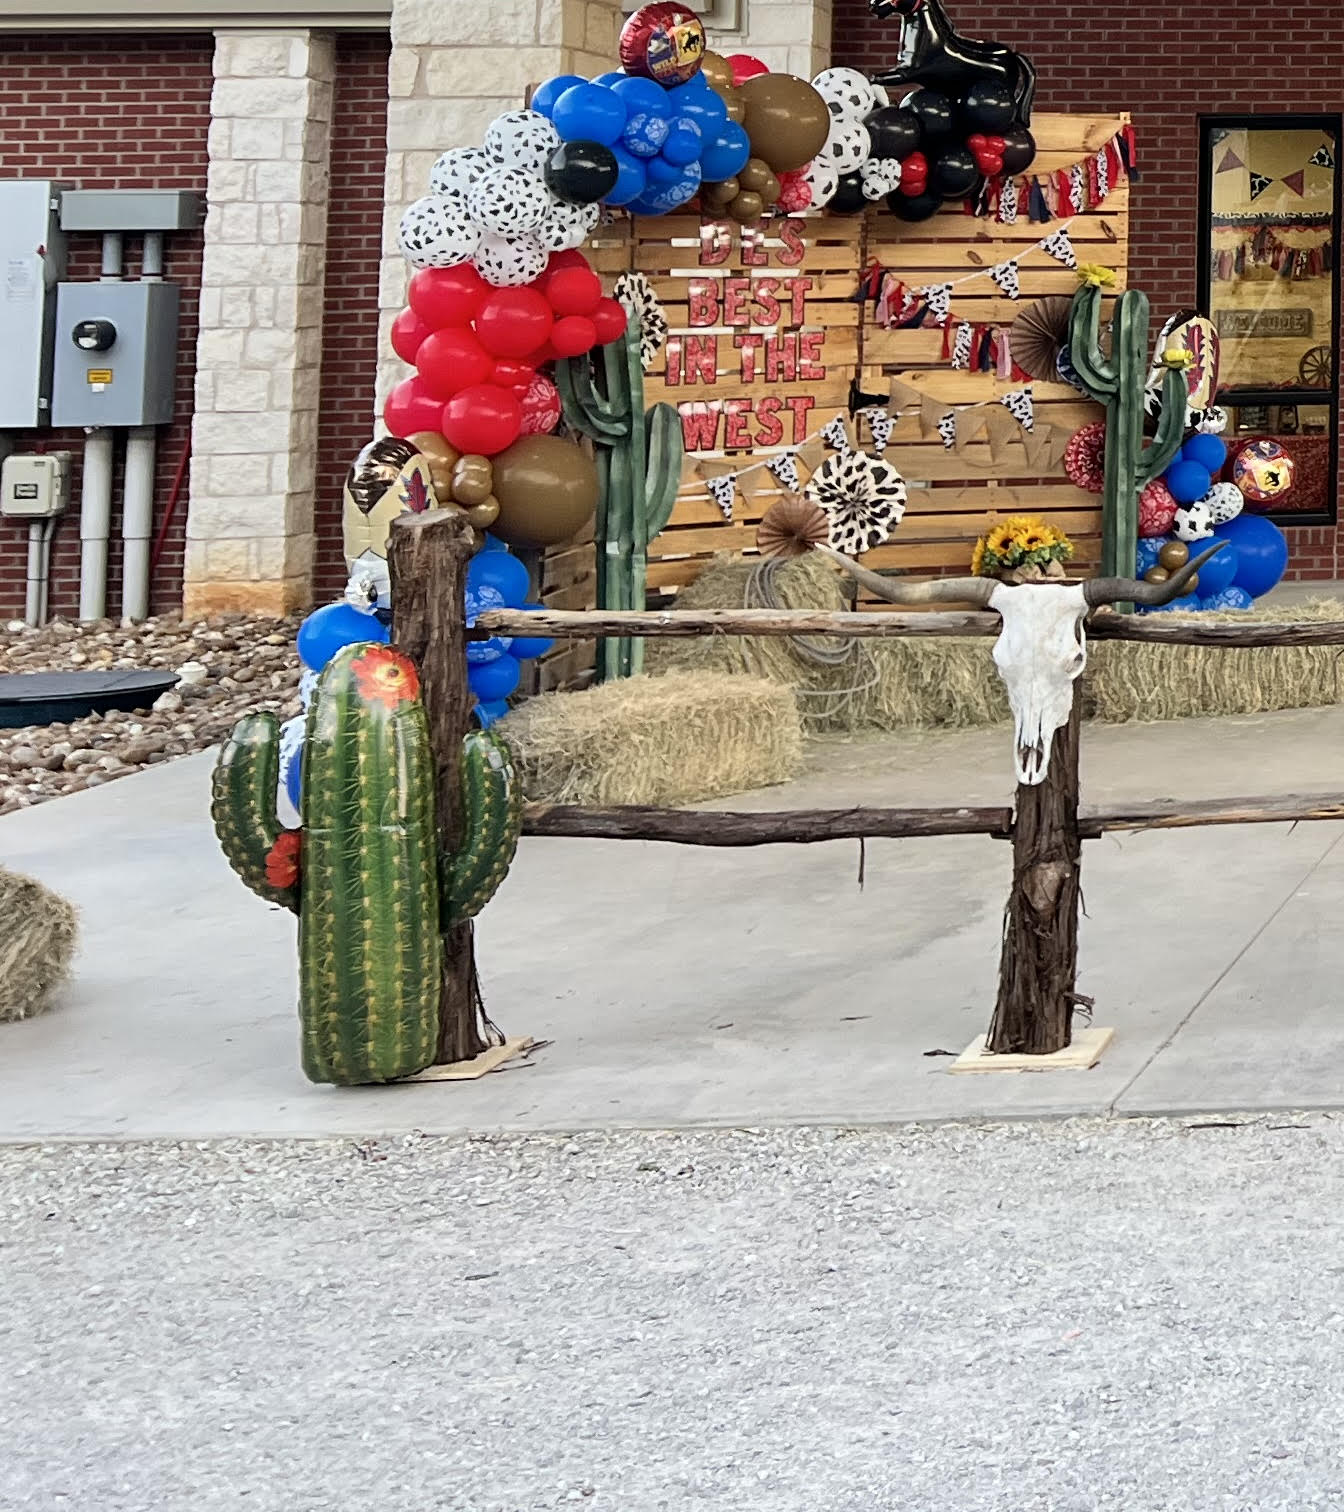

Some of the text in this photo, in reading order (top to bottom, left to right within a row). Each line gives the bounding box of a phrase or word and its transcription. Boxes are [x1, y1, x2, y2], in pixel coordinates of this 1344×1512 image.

[688, 276, 812, 327] BEST
[664, 331, 826, 386] IN THE
[677, 395, 815, 452] WEST
